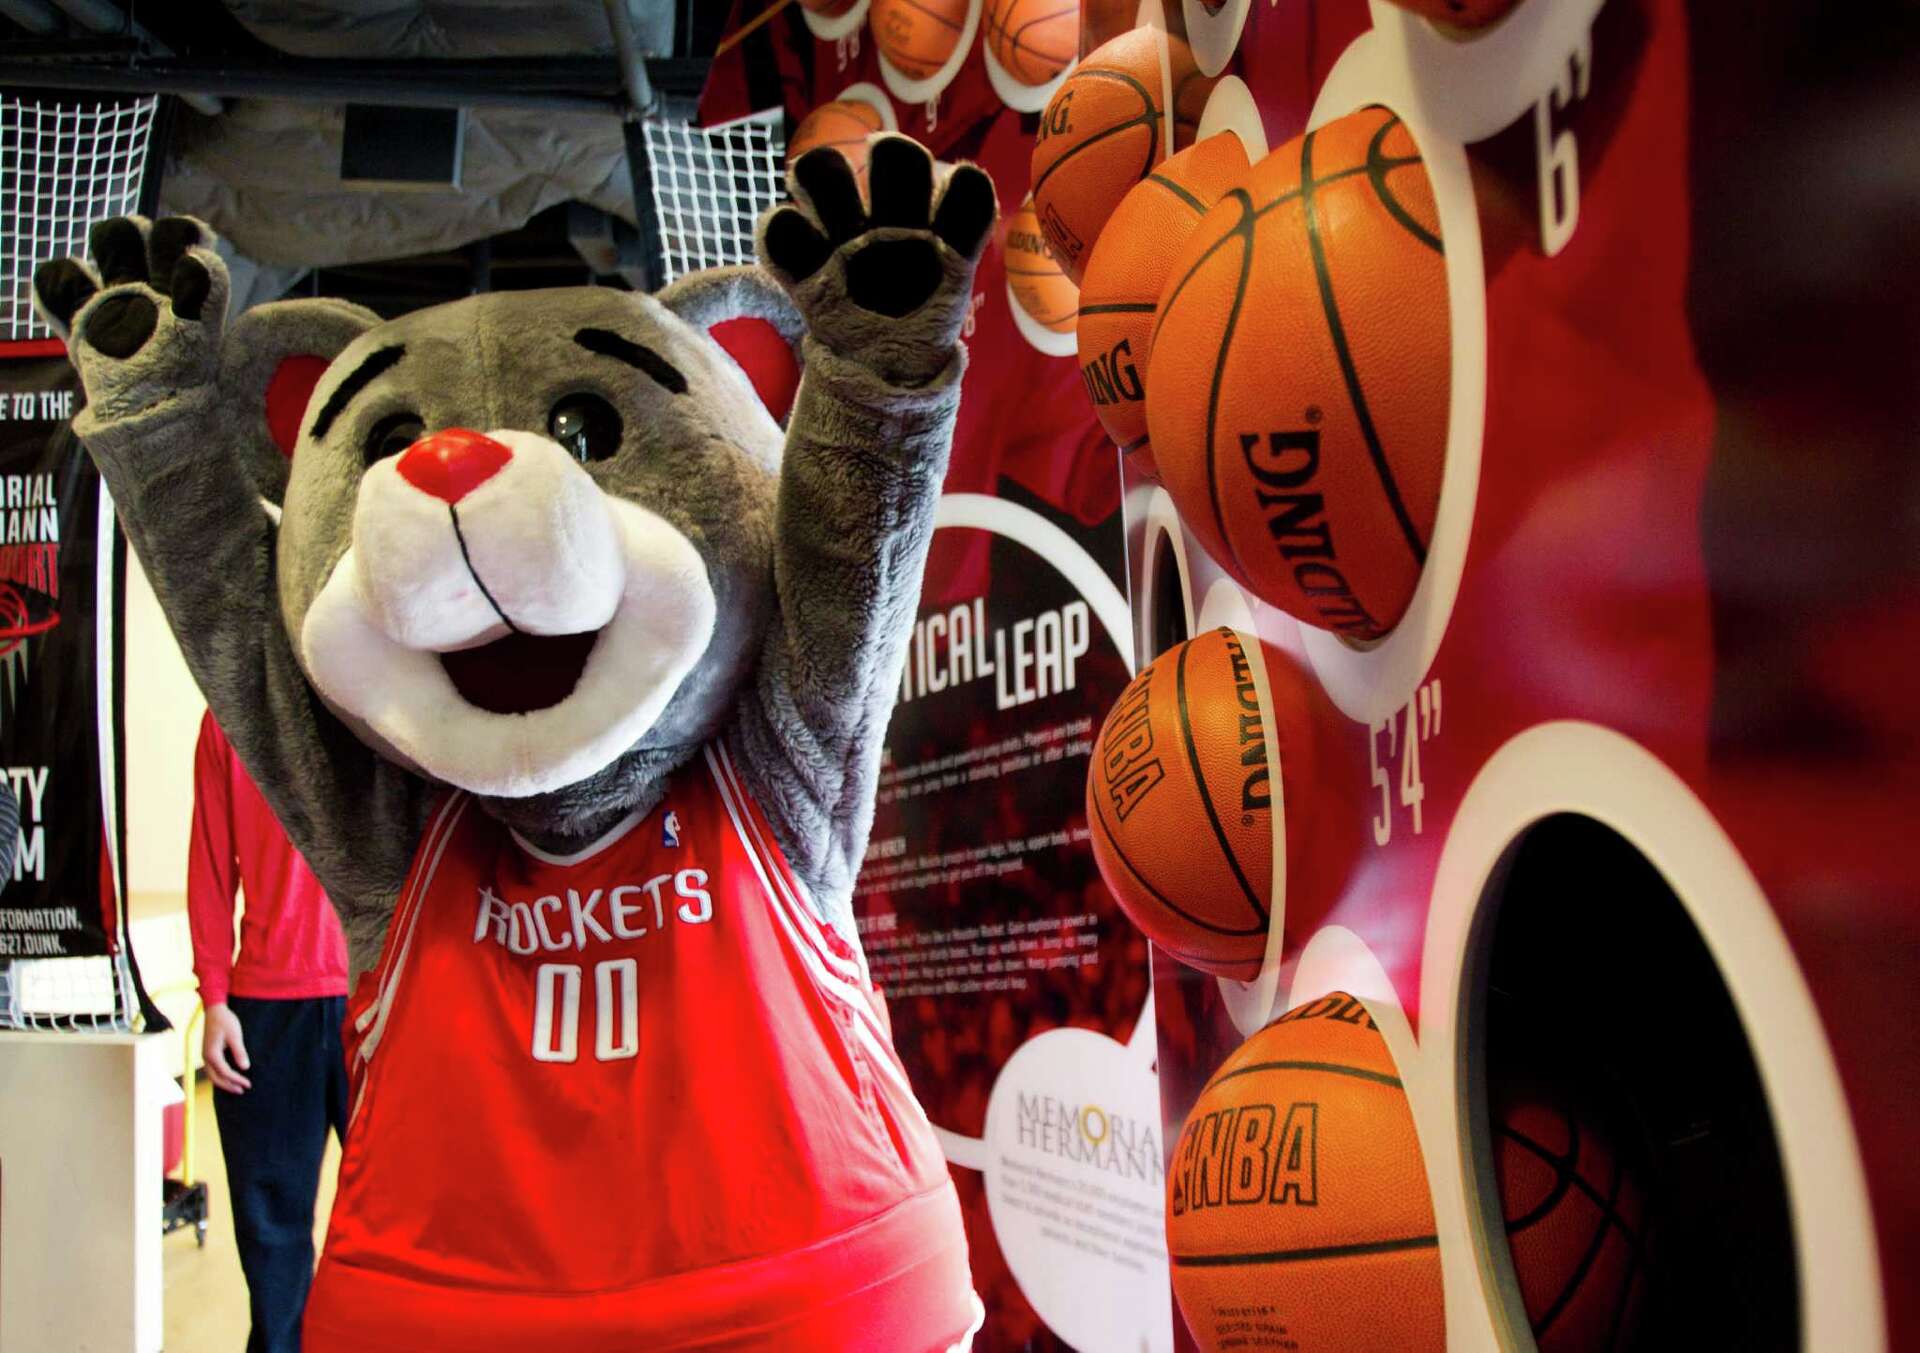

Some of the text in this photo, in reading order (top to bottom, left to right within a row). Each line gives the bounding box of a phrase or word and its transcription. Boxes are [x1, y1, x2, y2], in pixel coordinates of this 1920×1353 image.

[13, 392, 35, 420] TO
[40, 390, 74, 420] THE
[0, 506, 59, 544] ANN
[994, 600, 1089, 711] LEAP
[473, 868, 713, 956] ROCKETS
[532, 957, 639, 1064] 00
[1191, 1101, 1319, 1211] NBA
